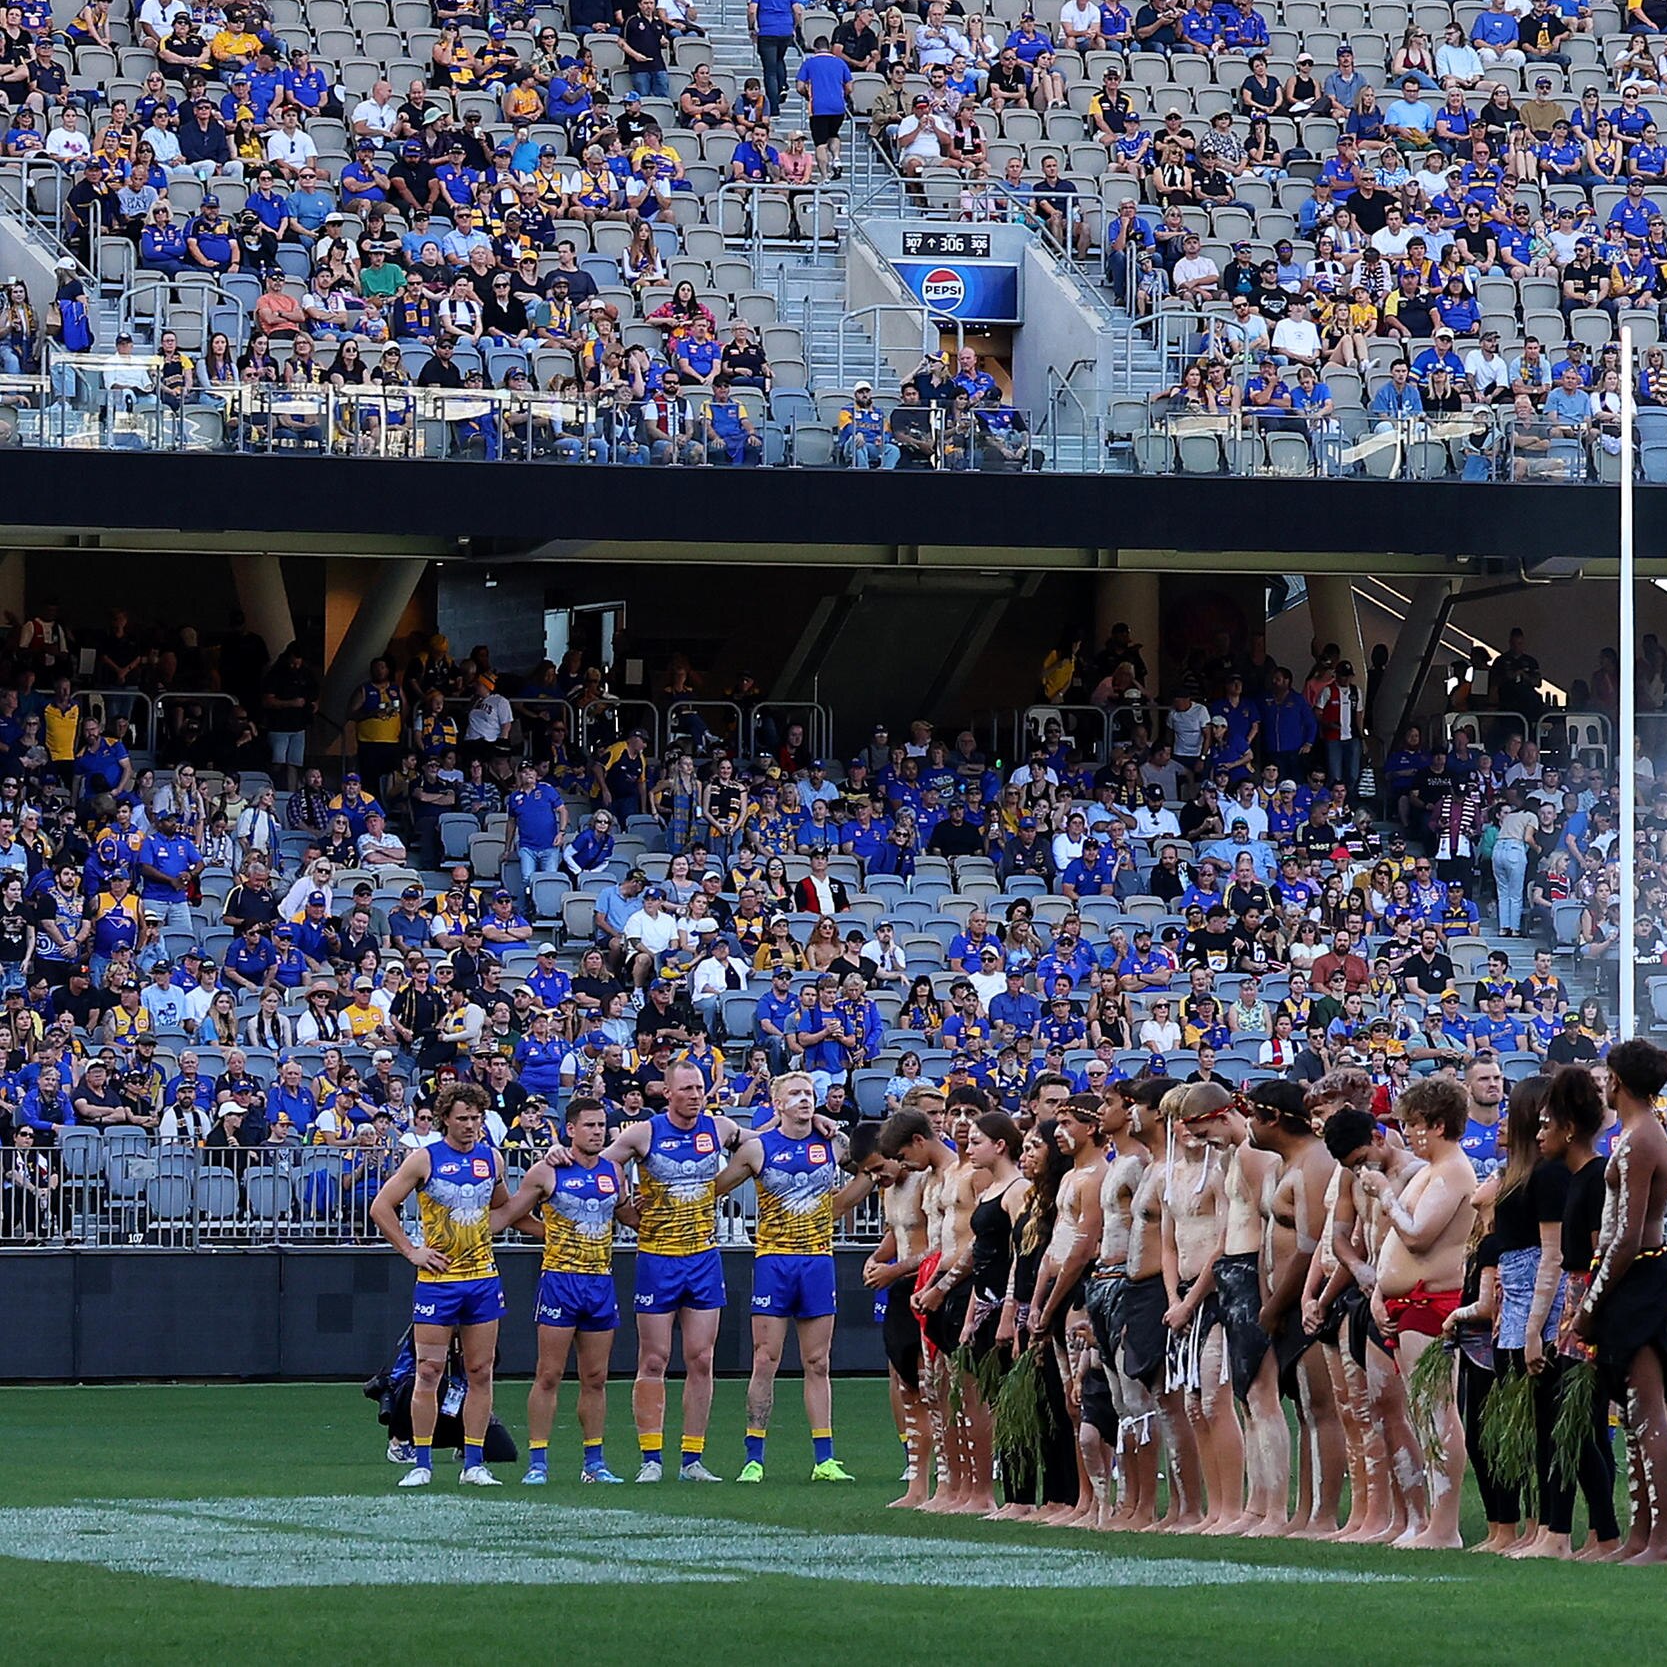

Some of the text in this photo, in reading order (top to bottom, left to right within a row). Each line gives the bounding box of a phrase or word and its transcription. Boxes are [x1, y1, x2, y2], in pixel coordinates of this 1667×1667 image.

[905, 237, 988, 252] 307 306 306
[925, 285, 962, 296] PEPSI
[128, 1233, 144, 1243] 107
